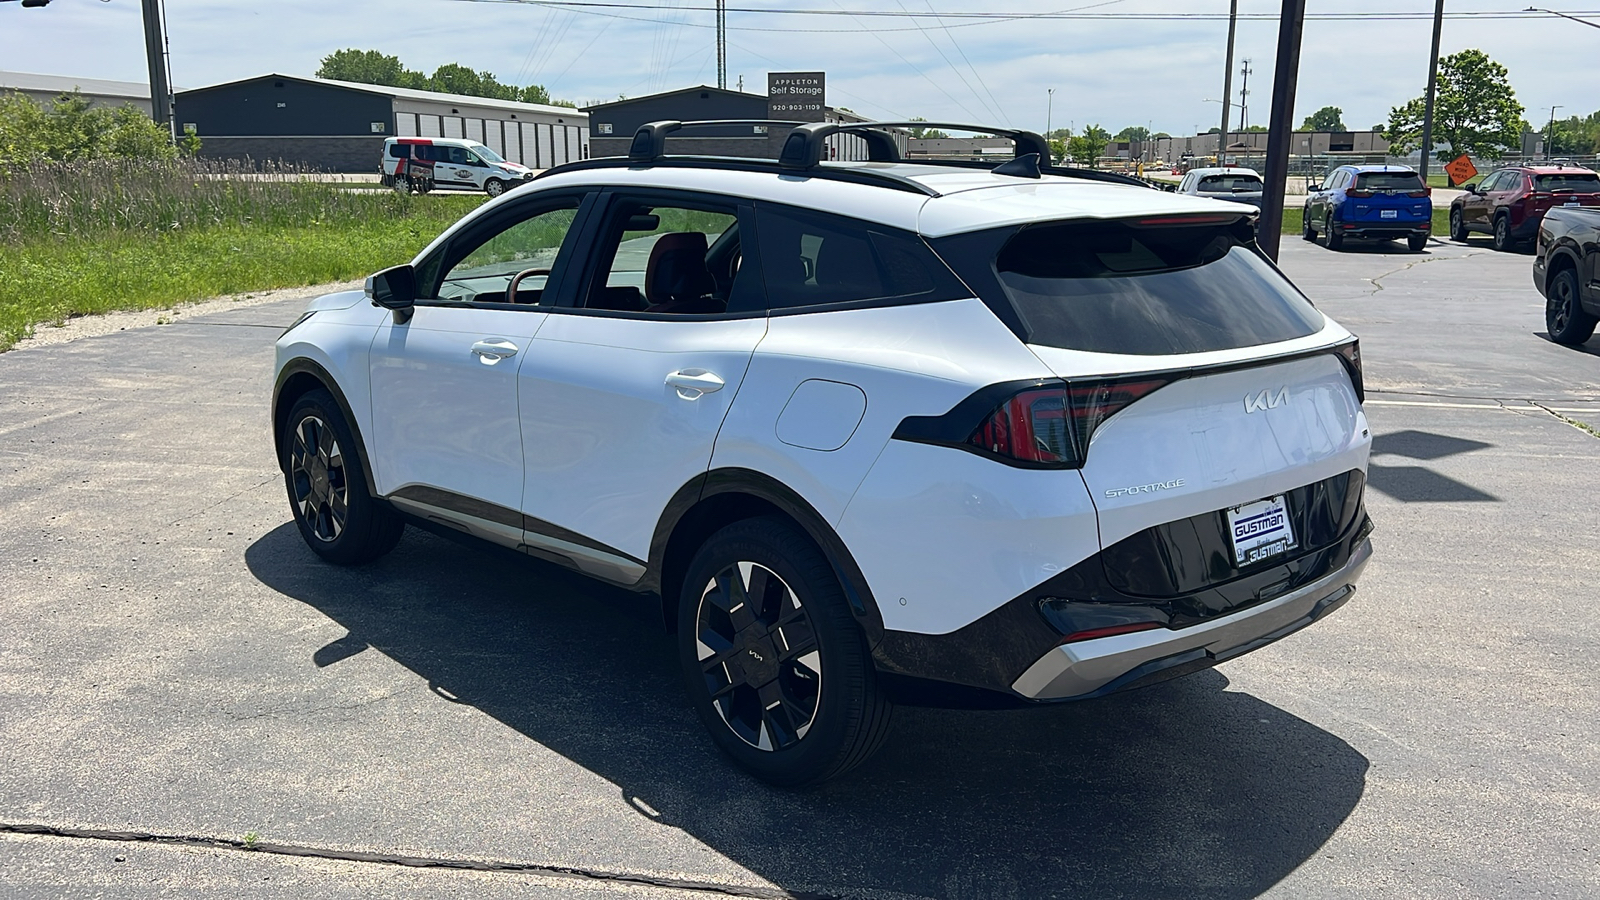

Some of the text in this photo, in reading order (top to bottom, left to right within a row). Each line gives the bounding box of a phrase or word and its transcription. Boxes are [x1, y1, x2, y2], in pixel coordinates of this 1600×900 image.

[771, 86, 822, 95] Self Storage
[1104, 478, 1185, 498] SPORTAGE
